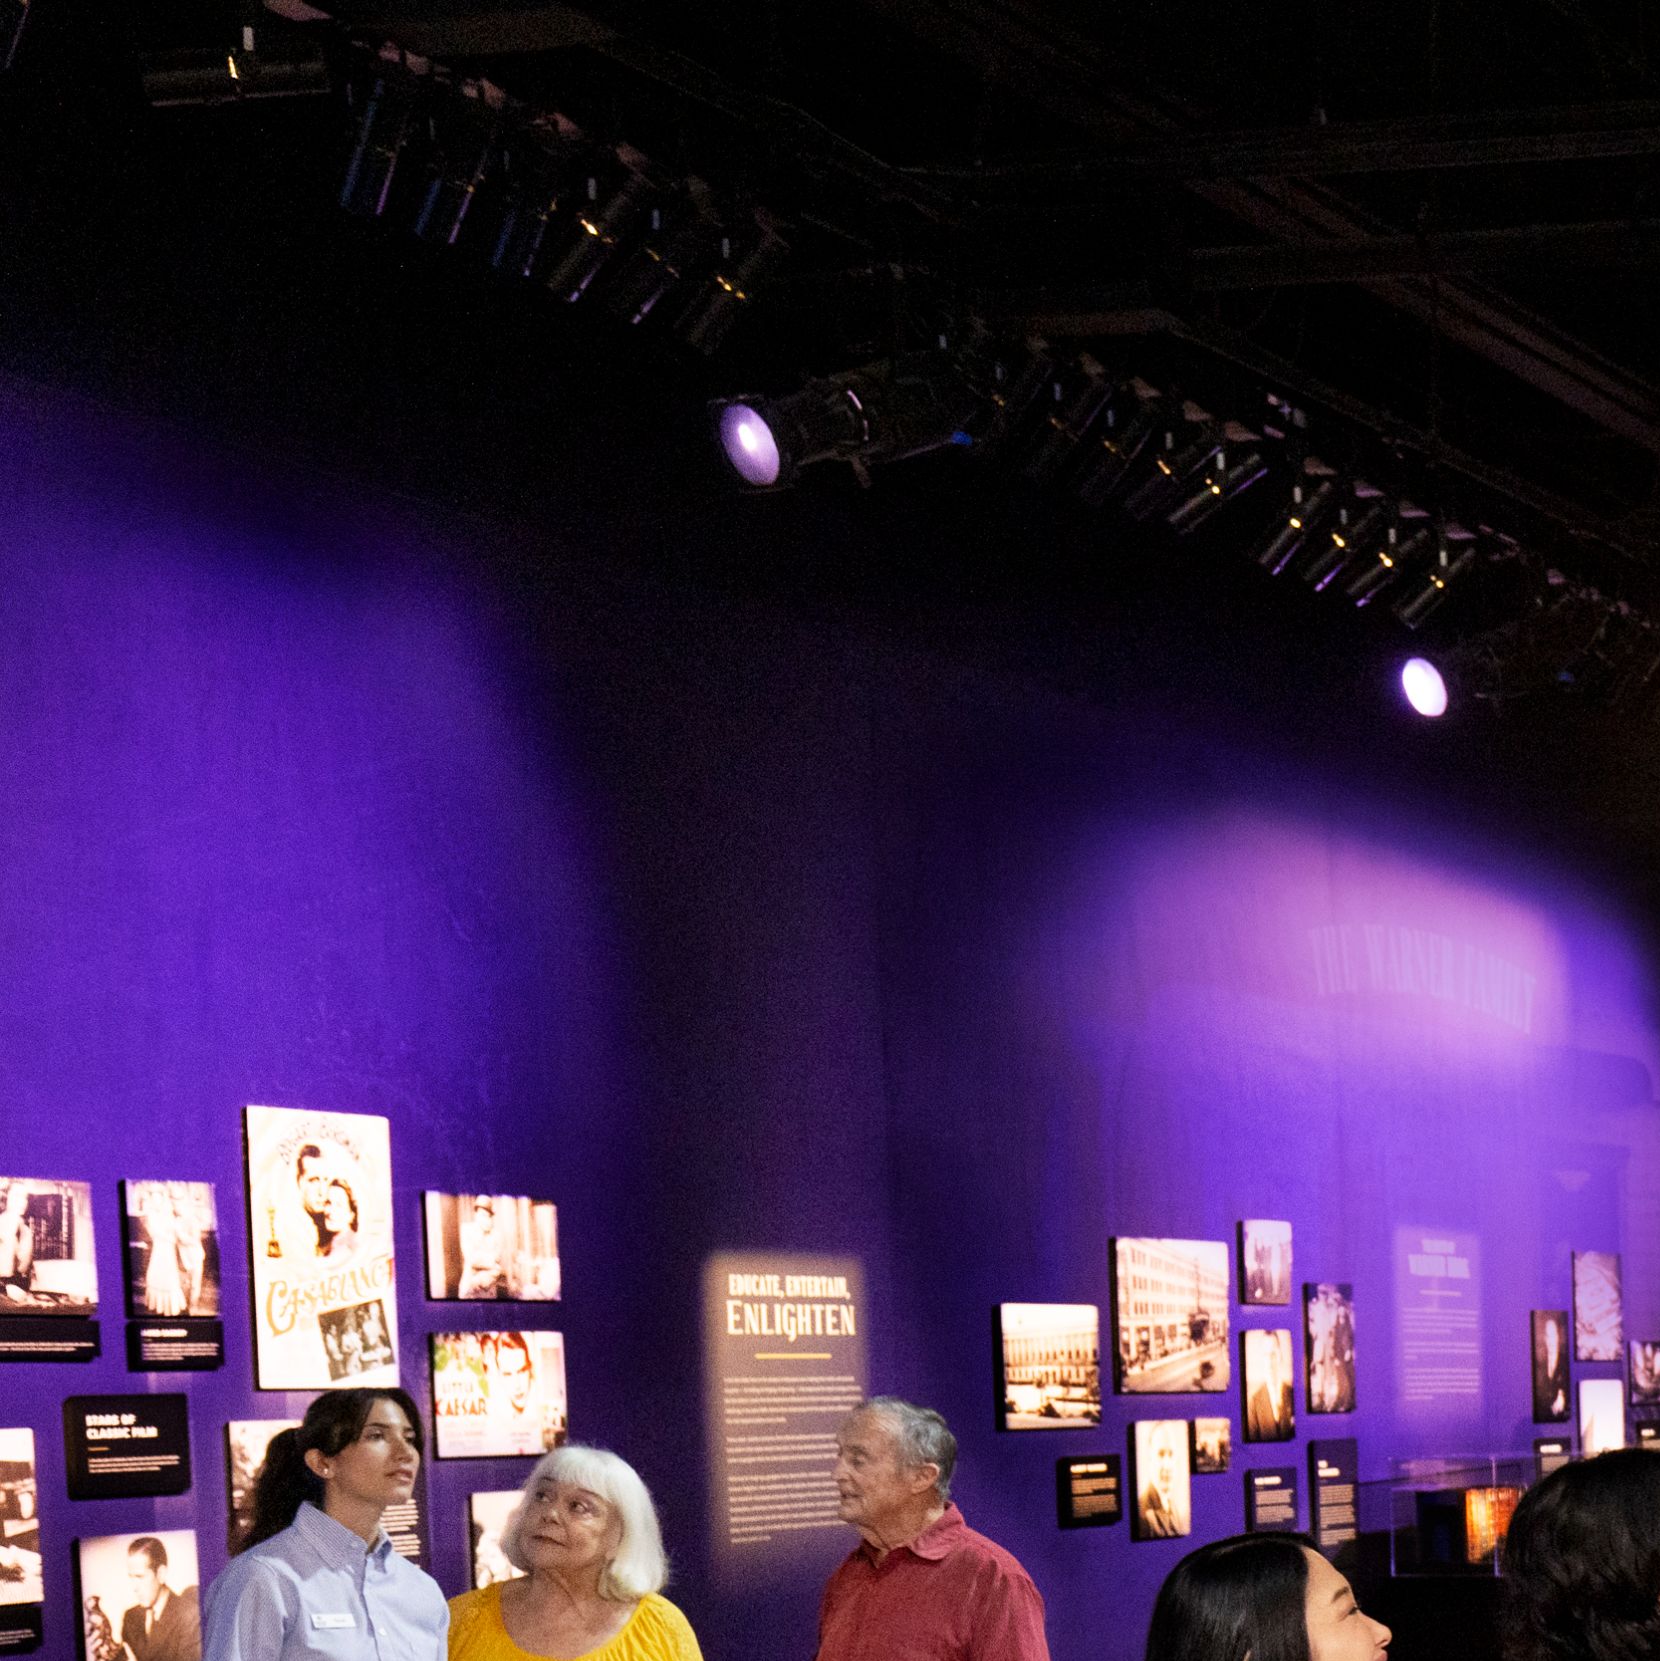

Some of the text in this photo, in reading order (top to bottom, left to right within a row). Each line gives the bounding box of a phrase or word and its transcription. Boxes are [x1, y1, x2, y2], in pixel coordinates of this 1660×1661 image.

[728, 1273, 851, 1299] EDUCATE, ENTERTAIN,
[726, 1299, 856, 1341] ENLIGHTEN
